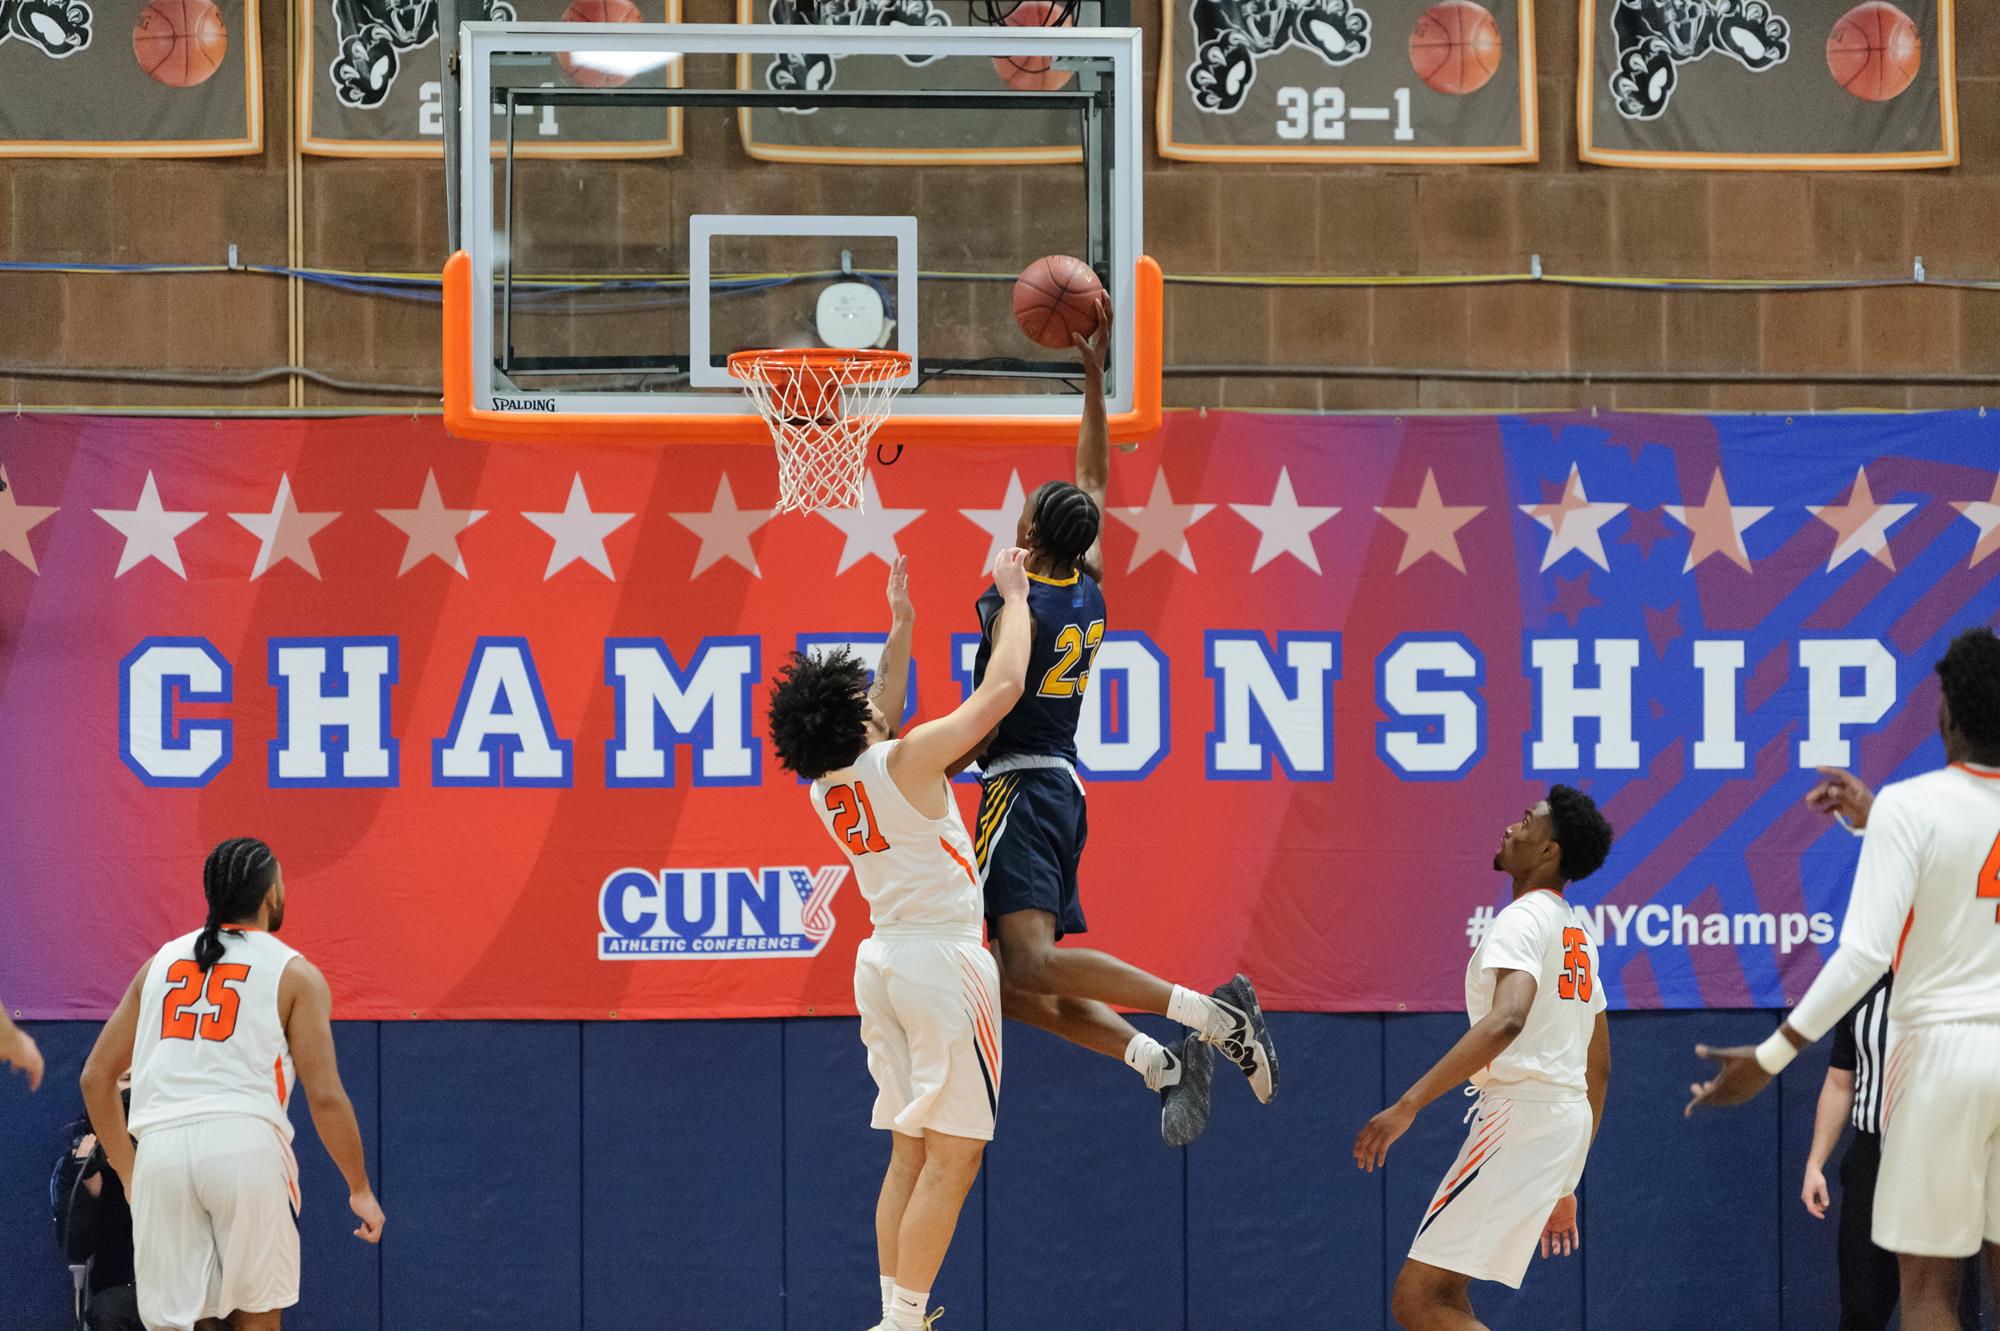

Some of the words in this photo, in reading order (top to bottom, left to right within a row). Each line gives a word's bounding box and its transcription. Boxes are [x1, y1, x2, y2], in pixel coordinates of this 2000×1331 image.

[419, 81, 559, 135] 2-1
[1276, 86, 1414, 140] 32-1
[492, 397, 556, 412] SPALDING
[119, 633, 1899, 787] CHAMONSHIP
[825, 781, 890, 855] 21
[603, 867, 848, 939] CUNY
[1466, 904, 1834, 953] #NYChamps
[609, 939, 686, 952] ATHLETIC
[692, 937, 800, 951] CONFERENCE
[1558, 926, 1592, 1003] 35
[160, 959, 251, 1042] 25
